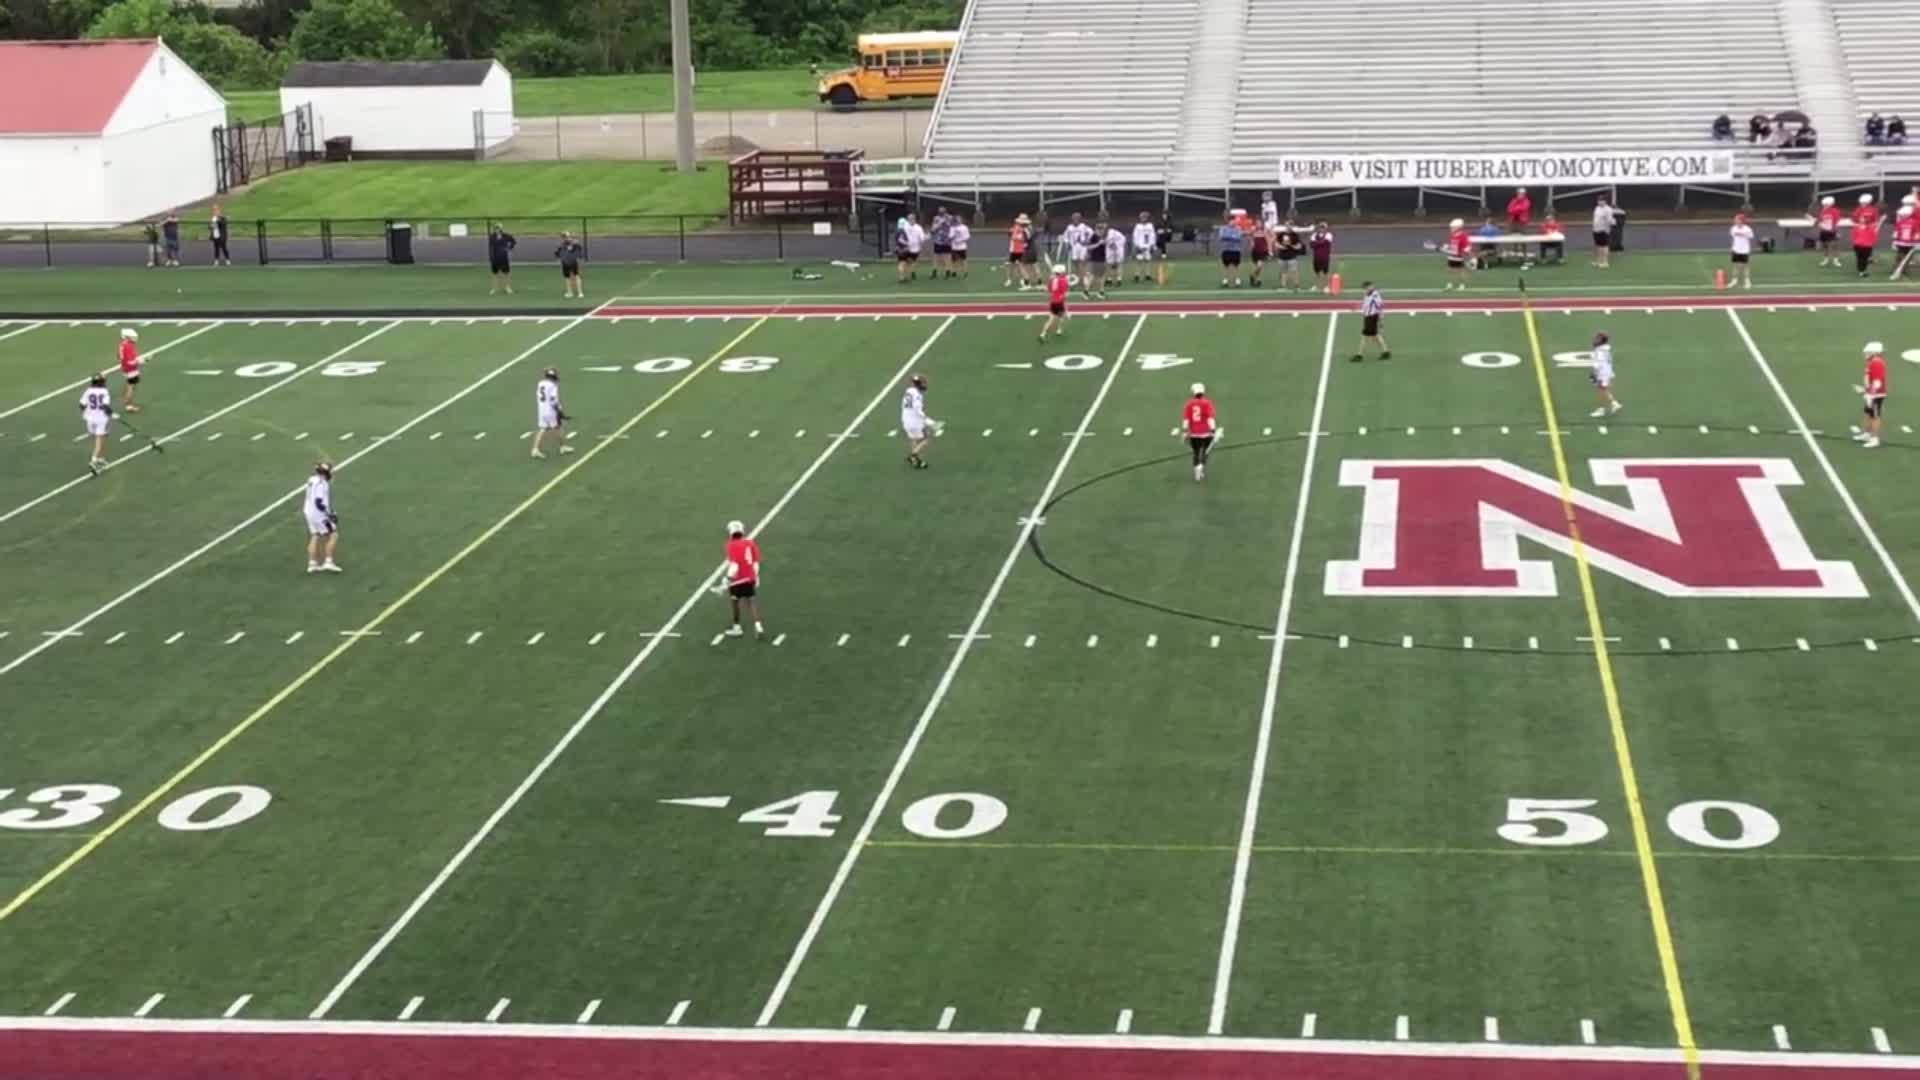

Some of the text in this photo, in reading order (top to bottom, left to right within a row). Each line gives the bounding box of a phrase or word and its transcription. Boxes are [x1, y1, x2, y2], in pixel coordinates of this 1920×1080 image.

[1284, 160, 1343, 173] HUBER
[1350, 156, 1708, 179] VISIT HUBERAUTOMOTIVE.COM
[1191, 405, 1201, 422] 2
[1324, 458, 1868, 597] N
[744, 546, 753, 565] 4
